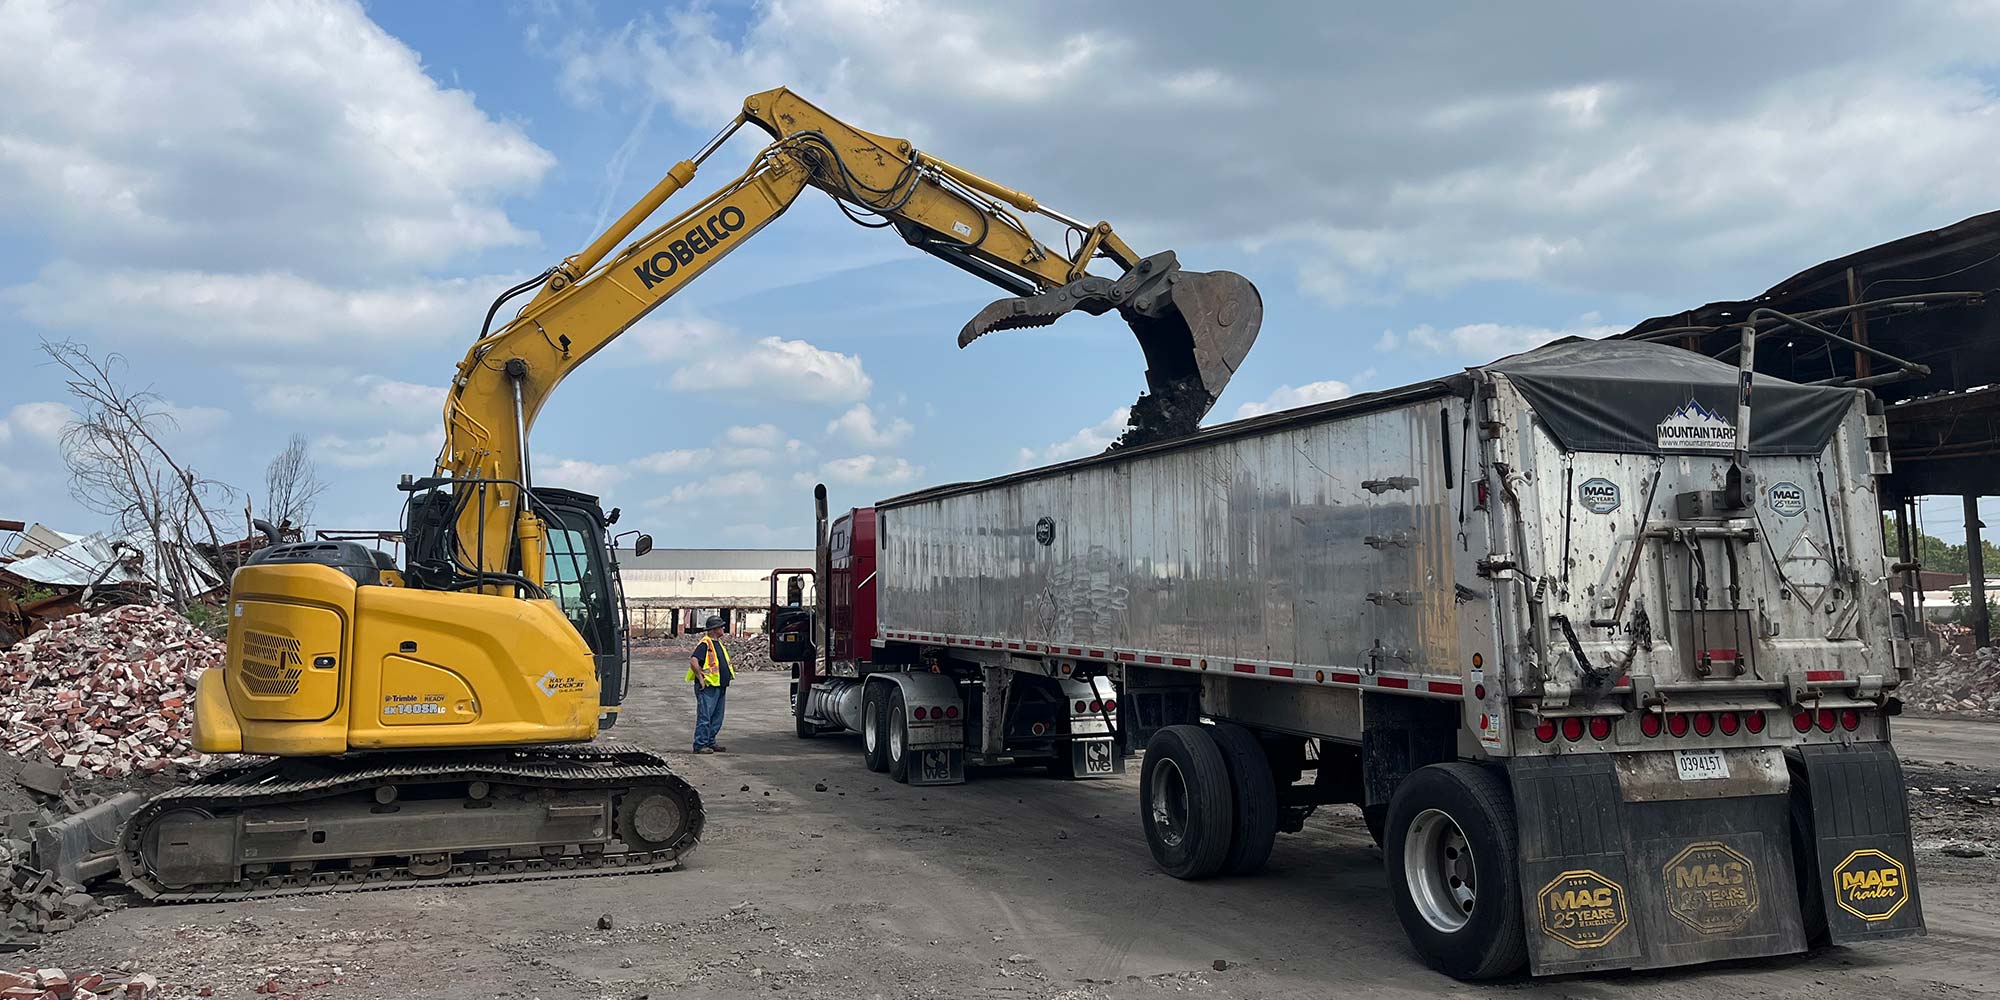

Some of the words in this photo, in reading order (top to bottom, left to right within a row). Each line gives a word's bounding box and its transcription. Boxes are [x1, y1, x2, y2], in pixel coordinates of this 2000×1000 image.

[633, 205, 745, 290] KOBELCO
[1658, 426, 1710, 439] MOUNTAIN
[1711, 427, 1737, 440] TARP
[1584, 486, 1615, 496] MAC
[1773, 490, 1801, 500] MAC
[1774, 500, 1785, 508] 25
[393, 694, 418, 703] Trimble
[1089, 760, 1111, 772] we
[1680, 756, 1722, 771] 039415T
[924, 767, 949, 779] we
[1675, 862, 1744, 889] MAC
[1842, 868, 1899, 891] MAC
[1550, 887, 1613, 911] MAC
[1702, 887, 1747, 902] YEARS
[1846, 882, 1897, 901] Trailer
[1553, 911, 1576, 929] 25
[1575, 908, 1616, 921] YEARS
